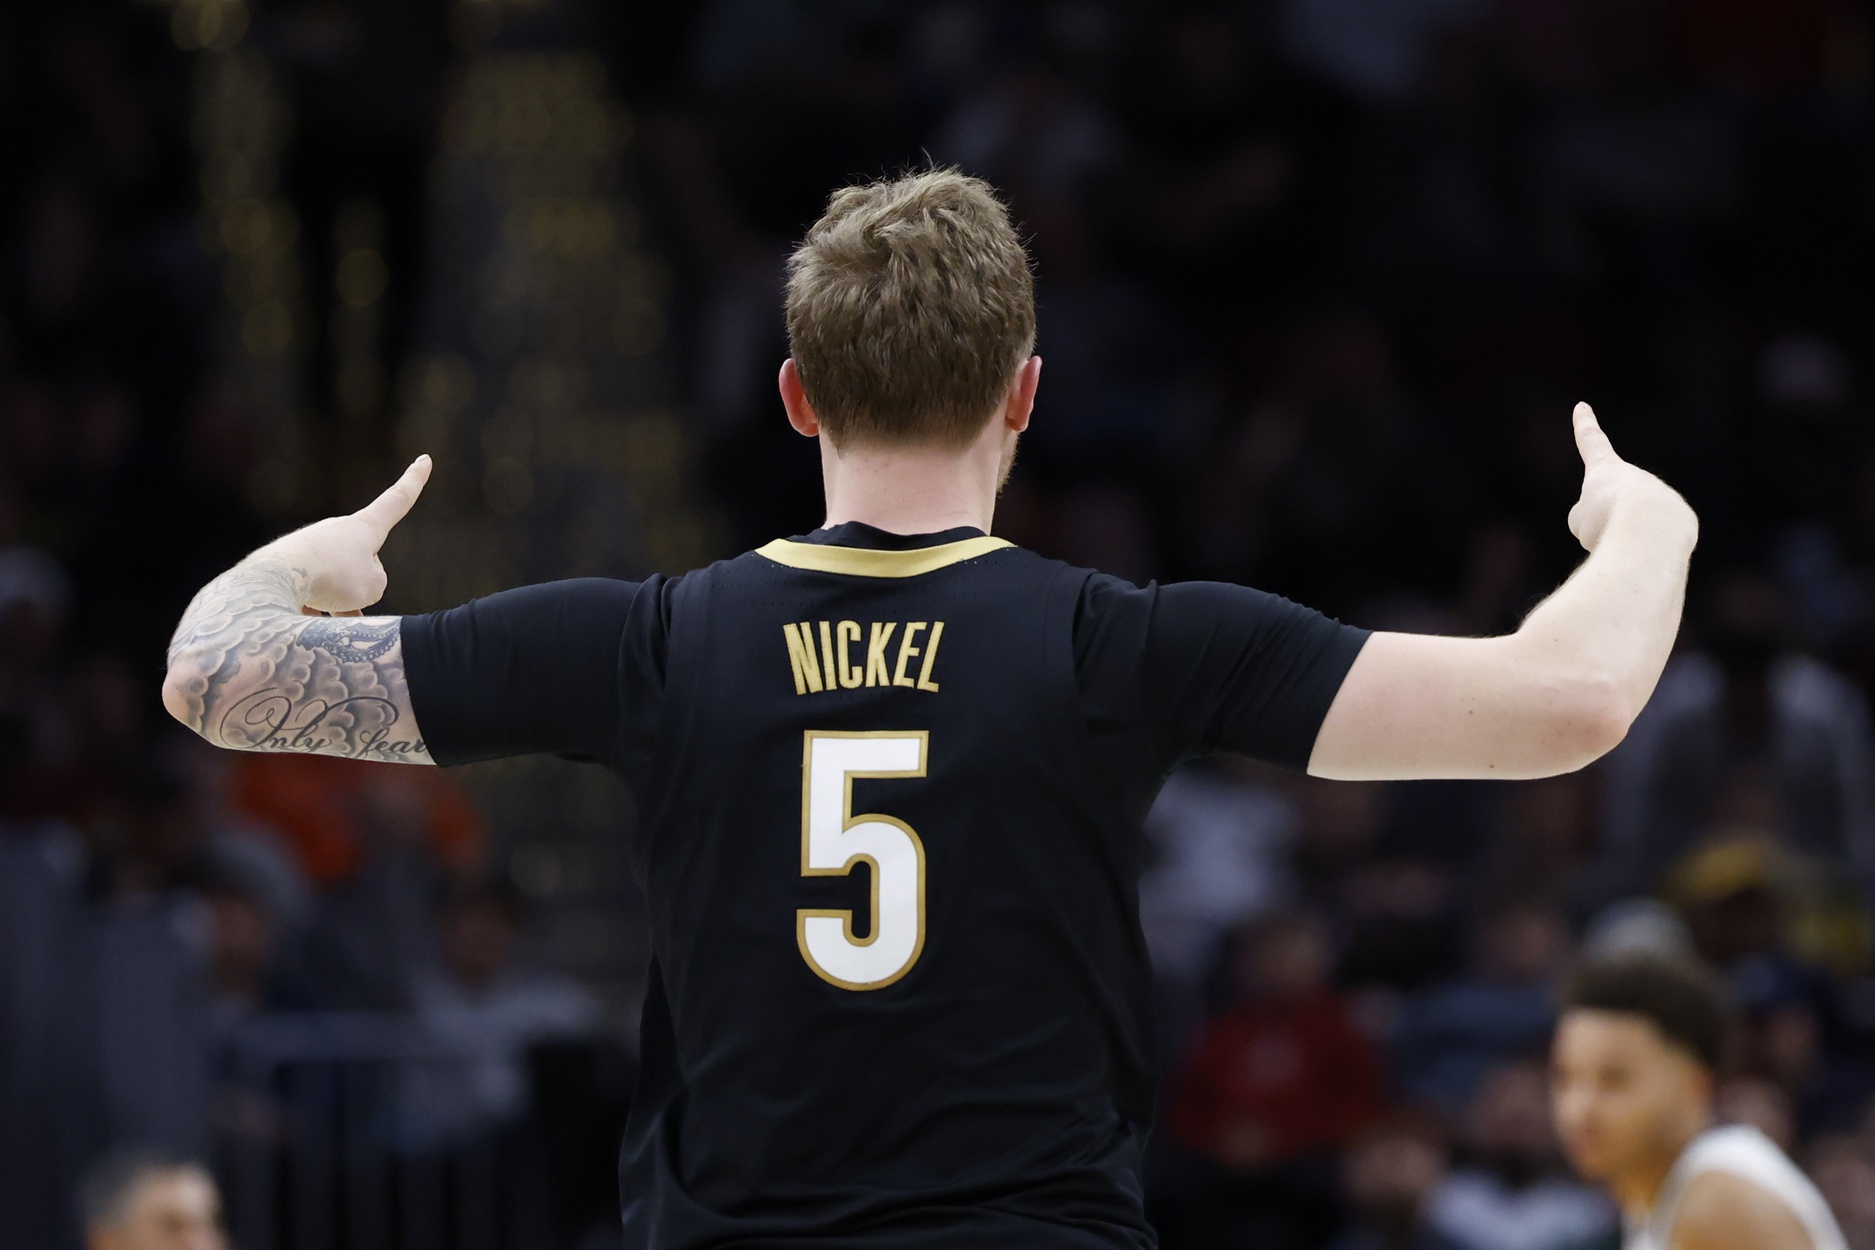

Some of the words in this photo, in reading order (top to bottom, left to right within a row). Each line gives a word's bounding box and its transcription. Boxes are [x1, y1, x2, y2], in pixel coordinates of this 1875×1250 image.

[783, 620, 945, 696] NICKEL
[220, 686, 345, 753] Only
[796, 730, 929, 991] 5
